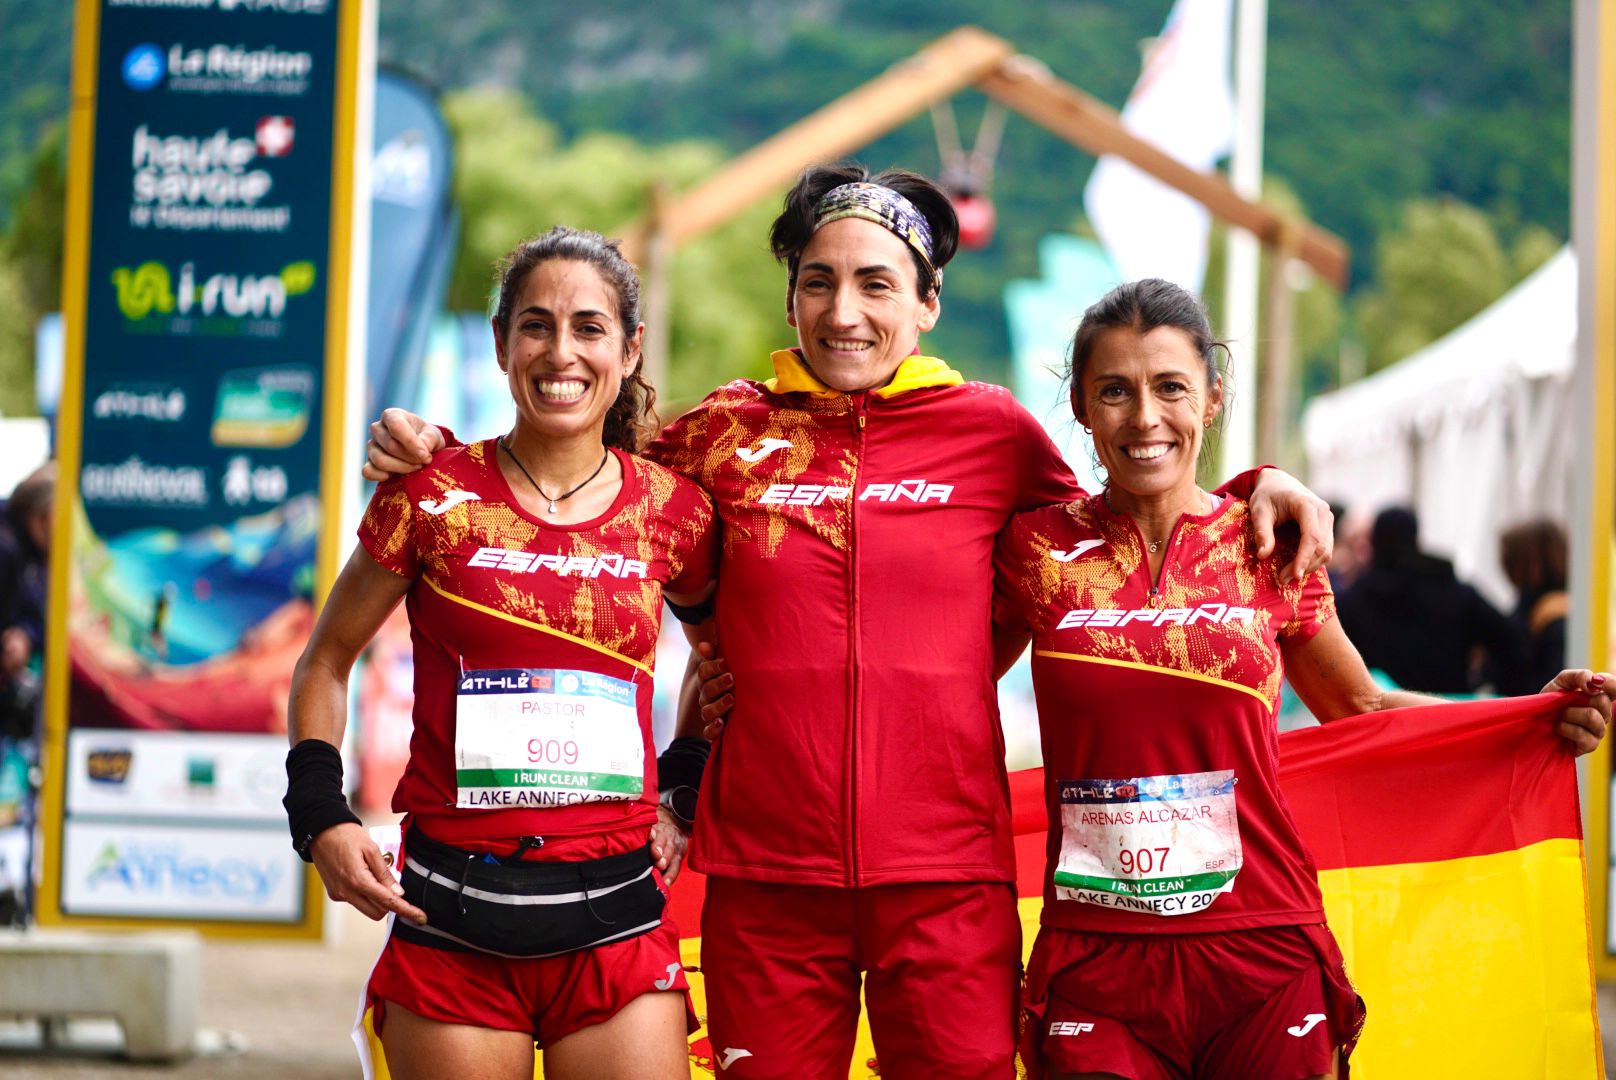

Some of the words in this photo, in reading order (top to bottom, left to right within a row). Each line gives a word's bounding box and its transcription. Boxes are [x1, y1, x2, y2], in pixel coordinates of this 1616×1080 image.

[168, 43, 204, 76] La
[132, 124, 257, 172] haute
[133, 168, 273, 207] savoie
[467, 547, 648, 579] ESPAÑA
[1056, 603, 1256, 630] ESPAÑA
[522, 701, 585, 717] PASTOR
[527, 738, 579, 765] 909
[521, 773, 547, 784] RUN
[470, 791, 512, 805] LAKE
[516, 791, 590, 806] ANNECY
[1081, 811, 1134, 825] ARENAS
[1138, 805, 1213, 824] ALCAZAR
[1119, 847, 1170, 874] 907
[1205, 859, 1225, 870] ESP
[1118, 881, 1141, 894] RUN
[1067, 889, 1111, 905] LAKE
[1114, 895, 1188, 913] ANNECY
[1191, 891, 1217, 908] 20
[1049, 1021, 1095, 1036] ESP
